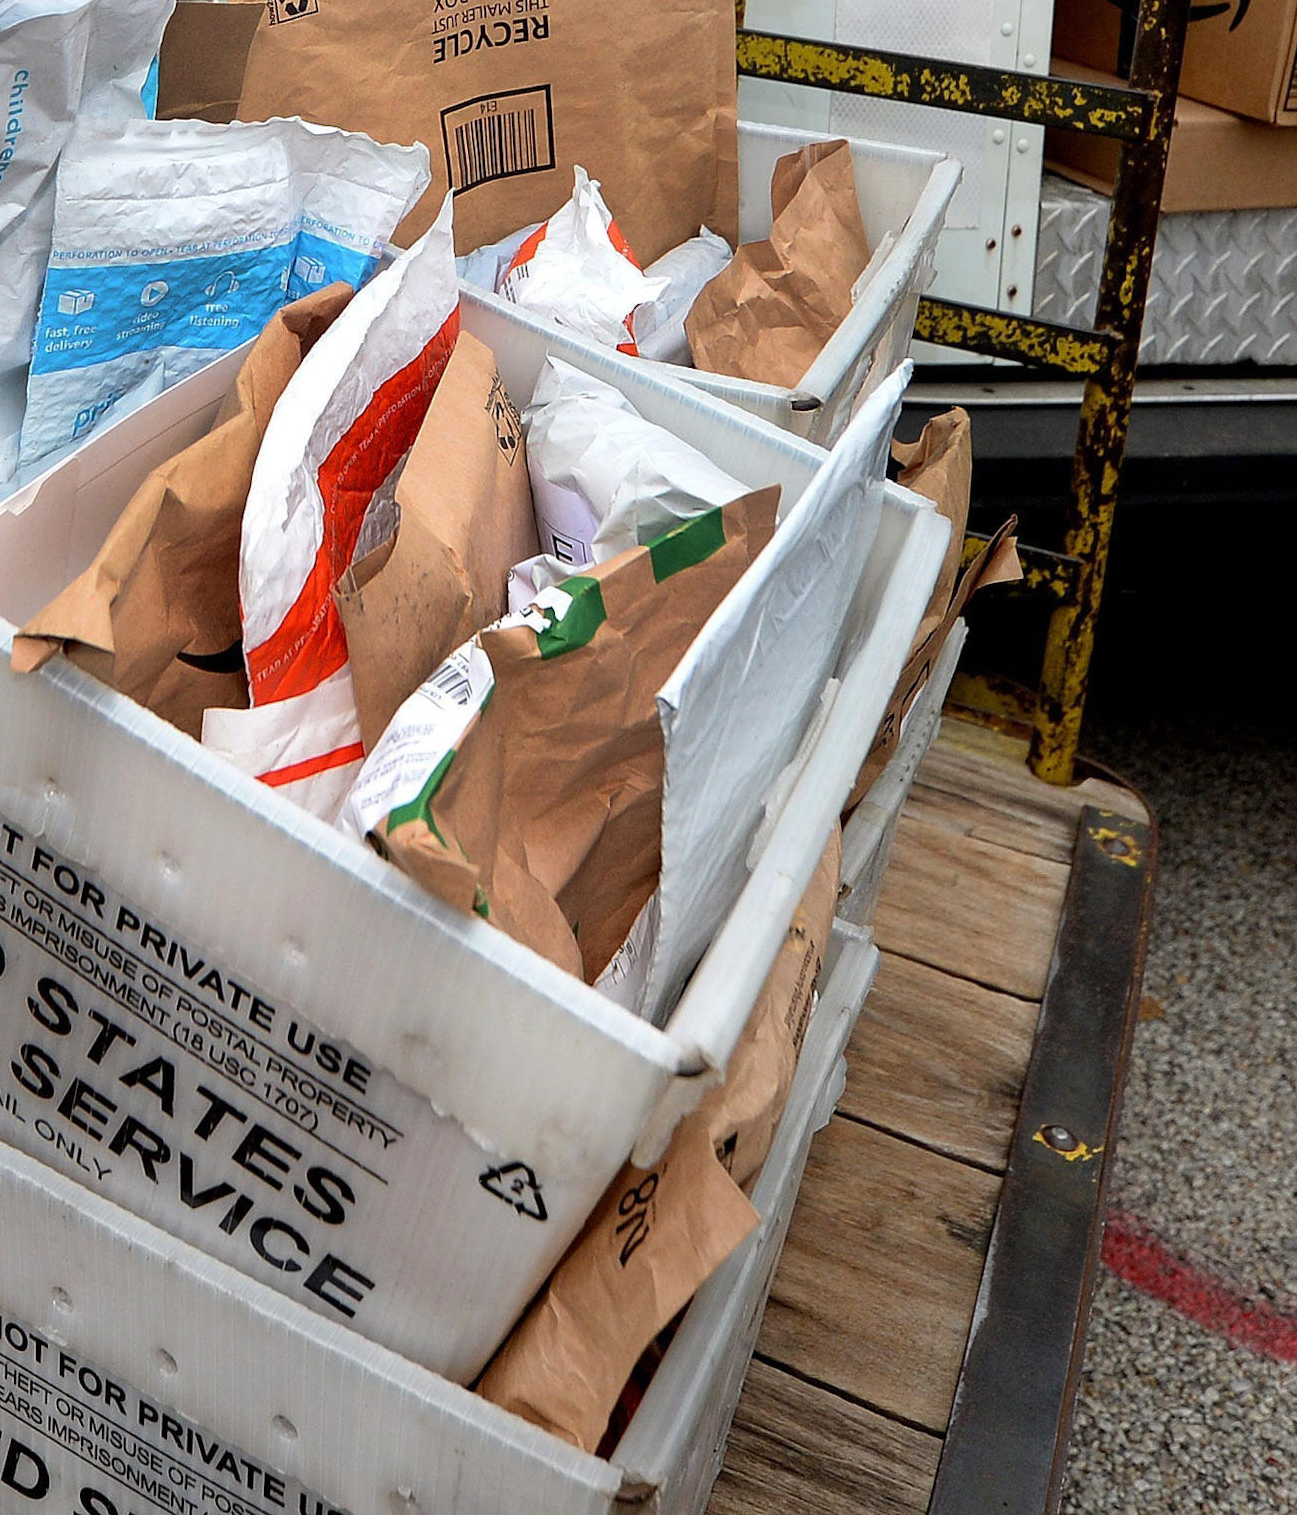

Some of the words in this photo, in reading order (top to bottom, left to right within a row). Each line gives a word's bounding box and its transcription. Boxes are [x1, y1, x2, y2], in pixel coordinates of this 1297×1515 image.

[430, 12, 459, 35] JUST
[433, 14, 550, 64] RECYCLE
[461, 1, 511, 24] MAILER
[52, 249, 124, 261] PERFORATION
[45, 326, 71, 340] fast,
[74, 324, 97, 336] free
[45, 338, 94, 355] delivery
[189, 315, 240, 328] listening
[31, 846, 106, 920] FOR
[115, 905, 276, 1034] PRIVATE
[286, 1021, 373, 1096] USE
[10, 904, 171, 1026] IMPRISONMENT
[172, 1021, 204, 1052] (18
[208, 1044, 257, 1087] USC
[263, 1082, 319, 1134] 1707)
[23, 890, 55, 923] OR
[57, 913, 139, 981] MISUSE
[141, 972, 175, 1000] OF
[176, 995, 262, 1068] POSTAL
[265, 1056, 398, 1150] PROPERTY
[26, 976, 357, 1226] STATES
[10, 1043, 376, 1319] SERVICE
[33, 1118, 111, 1181] ONLY
[47, 1415, 199, 1515] IMPRISONMENT
[56, 1397, 85, 1429] OR
[88, 1412, 163, 1476] MISUSE
[168, 1466, 197, 1491] OF
[58, 1350, 127, 1416] FOR
[138, 1399, 286, 1509] PRIVATE
